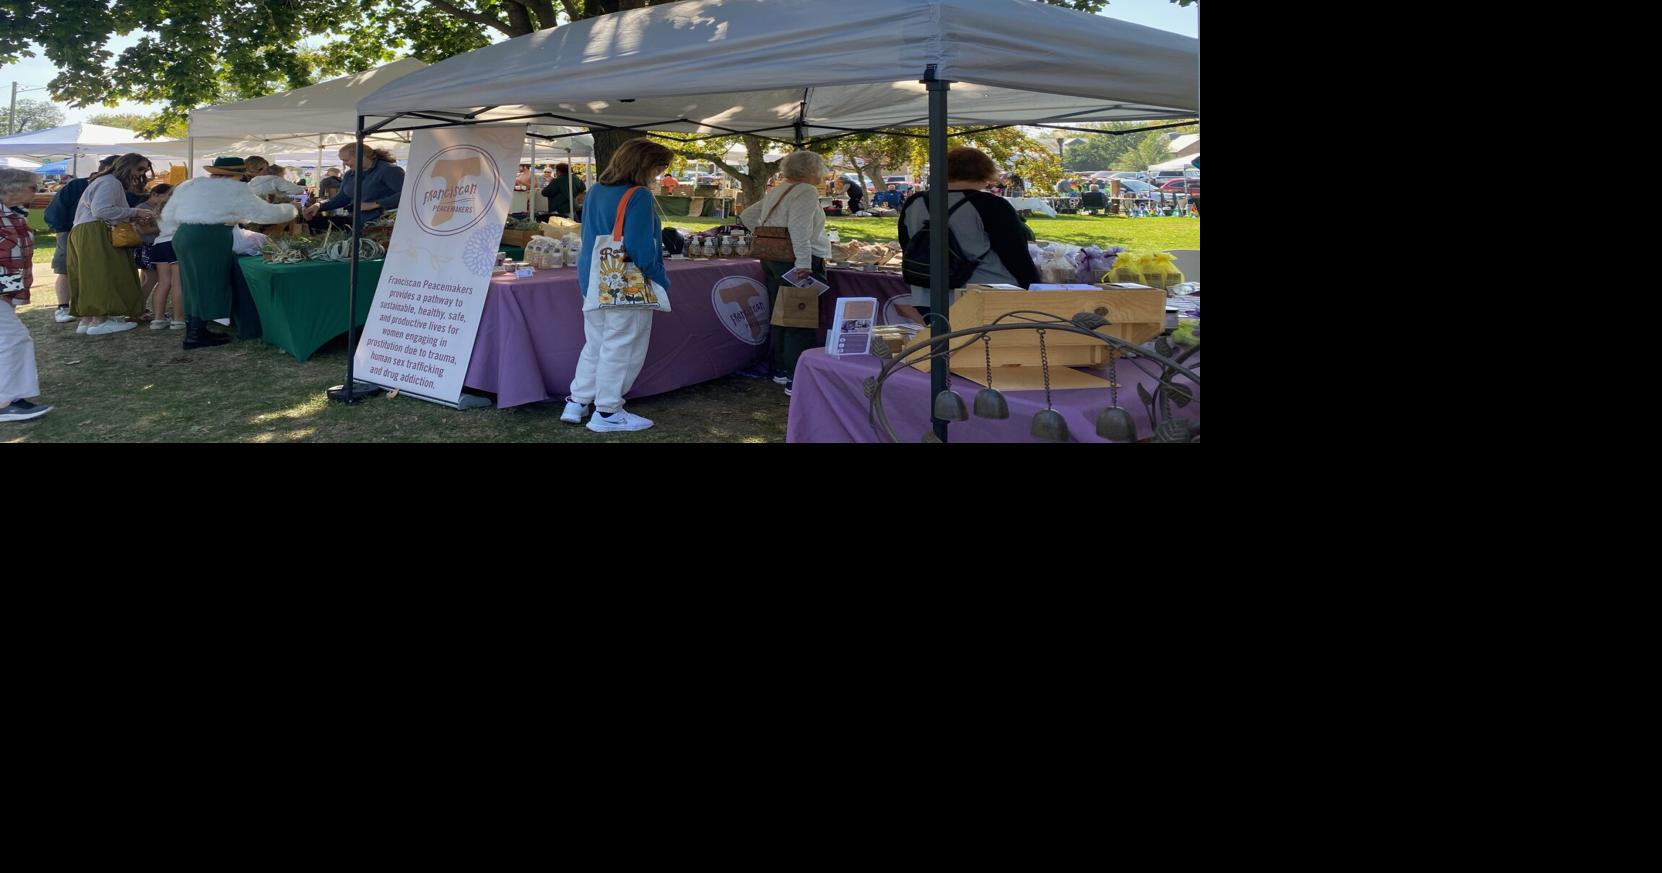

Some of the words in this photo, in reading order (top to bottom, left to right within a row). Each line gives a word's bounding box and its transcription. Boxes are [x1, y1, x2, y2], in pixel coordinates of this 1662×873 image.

[432, 205, 473, 214] PEACEMAKERS
[388, 275, 422, 288] Franciscan
[422, 280, 473, 295] Peacemakers
[389, 289, 415, 301] provides
[422, 294, 454, 308] pathway
[379, 313, 391, 322] and
[391, 315, 427, 329] productive
[428, 322, 446, 333] lives
[447, 325, 459, 336] for
[366, 337, 403, 352] prostitution
[404, 345, 417, 355] due
[382, 327, 403, 338] women
[405, 333, 438, 348] engaging
[370, 351, 392, 363] human
[392, 357, 405, 366] sex
[406, 360, 444, 377] trafficking
[370, 366, 382, 375] and
[382, 368, 399, 381] drug
[399, 375, 435, 389] addiction.
